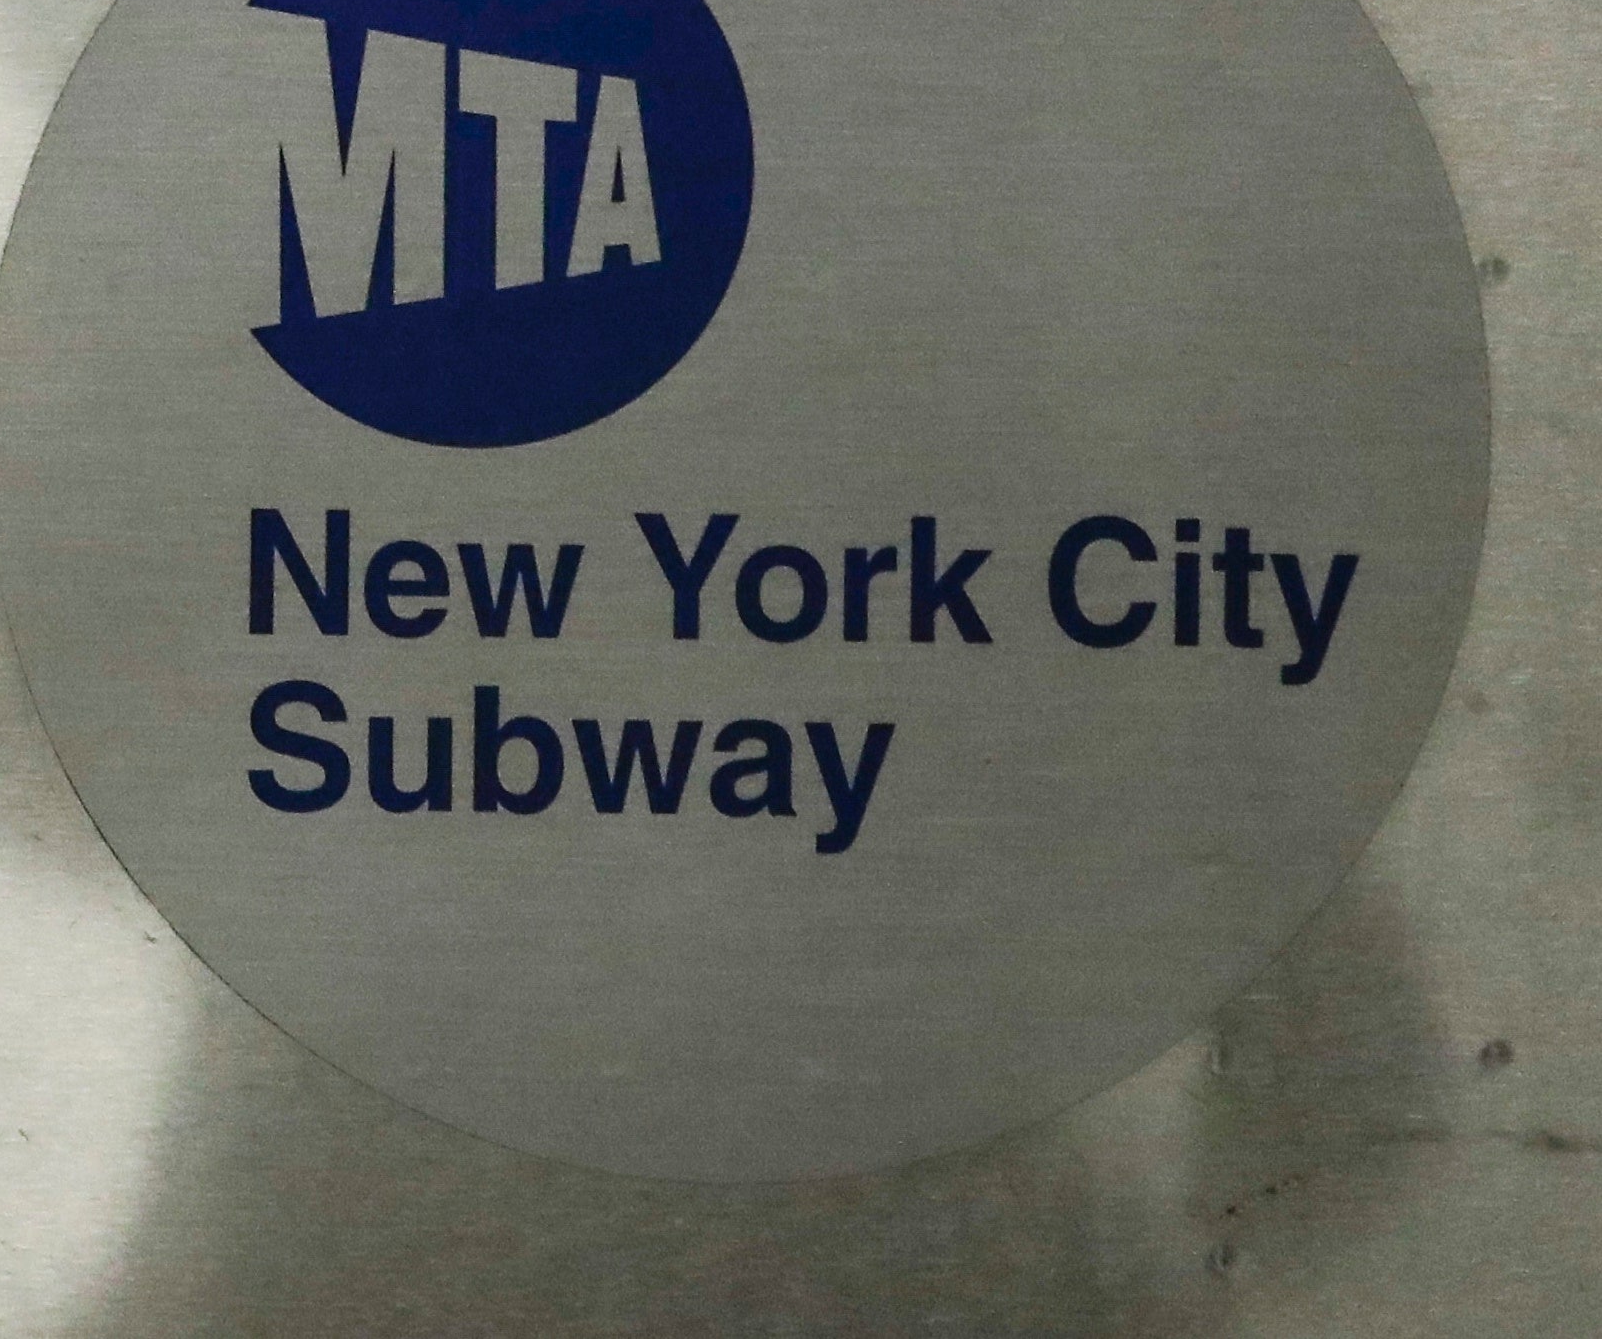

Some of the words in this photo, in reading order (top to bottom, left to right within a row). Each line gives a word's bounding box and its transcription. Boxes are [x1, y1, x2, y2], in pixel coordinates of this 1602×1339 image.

[248, 5, 662, 329] MTA
[249, 508, 585, 639] New
[634, 512, 994, 646] York
[1047, 514, 1361, 688] City
[248, 680, 896, 856] Subway
